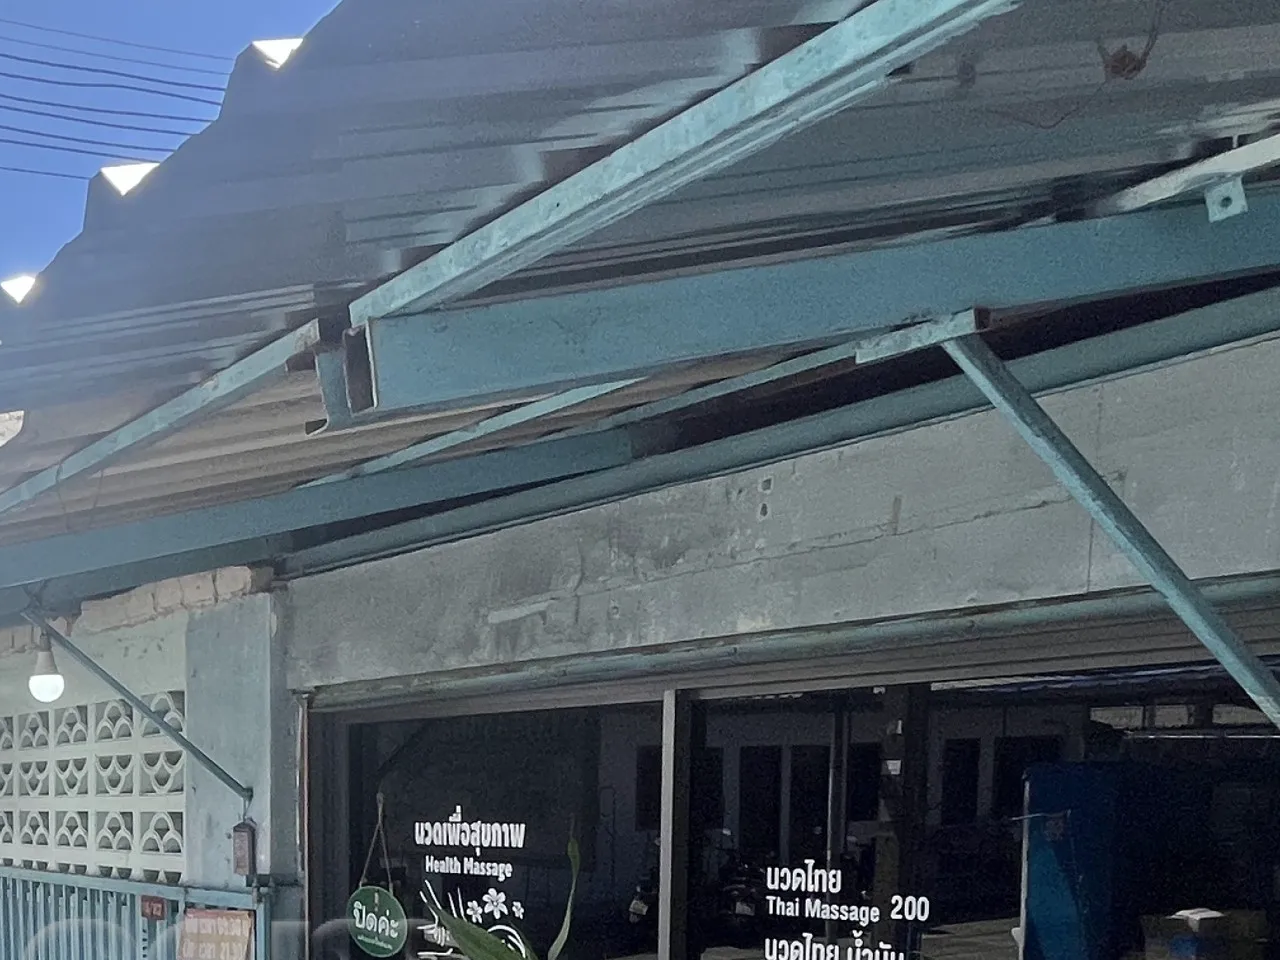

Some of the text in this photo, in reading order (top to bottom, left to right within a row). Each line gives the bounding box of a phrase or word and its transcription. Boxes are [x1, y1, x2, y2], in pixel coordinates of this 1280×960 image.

[425, 855, 513, 882] Health Massage
[766, 858, 842, 894] นวดไทย
[353, 900, 399, 939] ปิดค่ะ
[765, 894, 930, 928] Thai Massage 200
